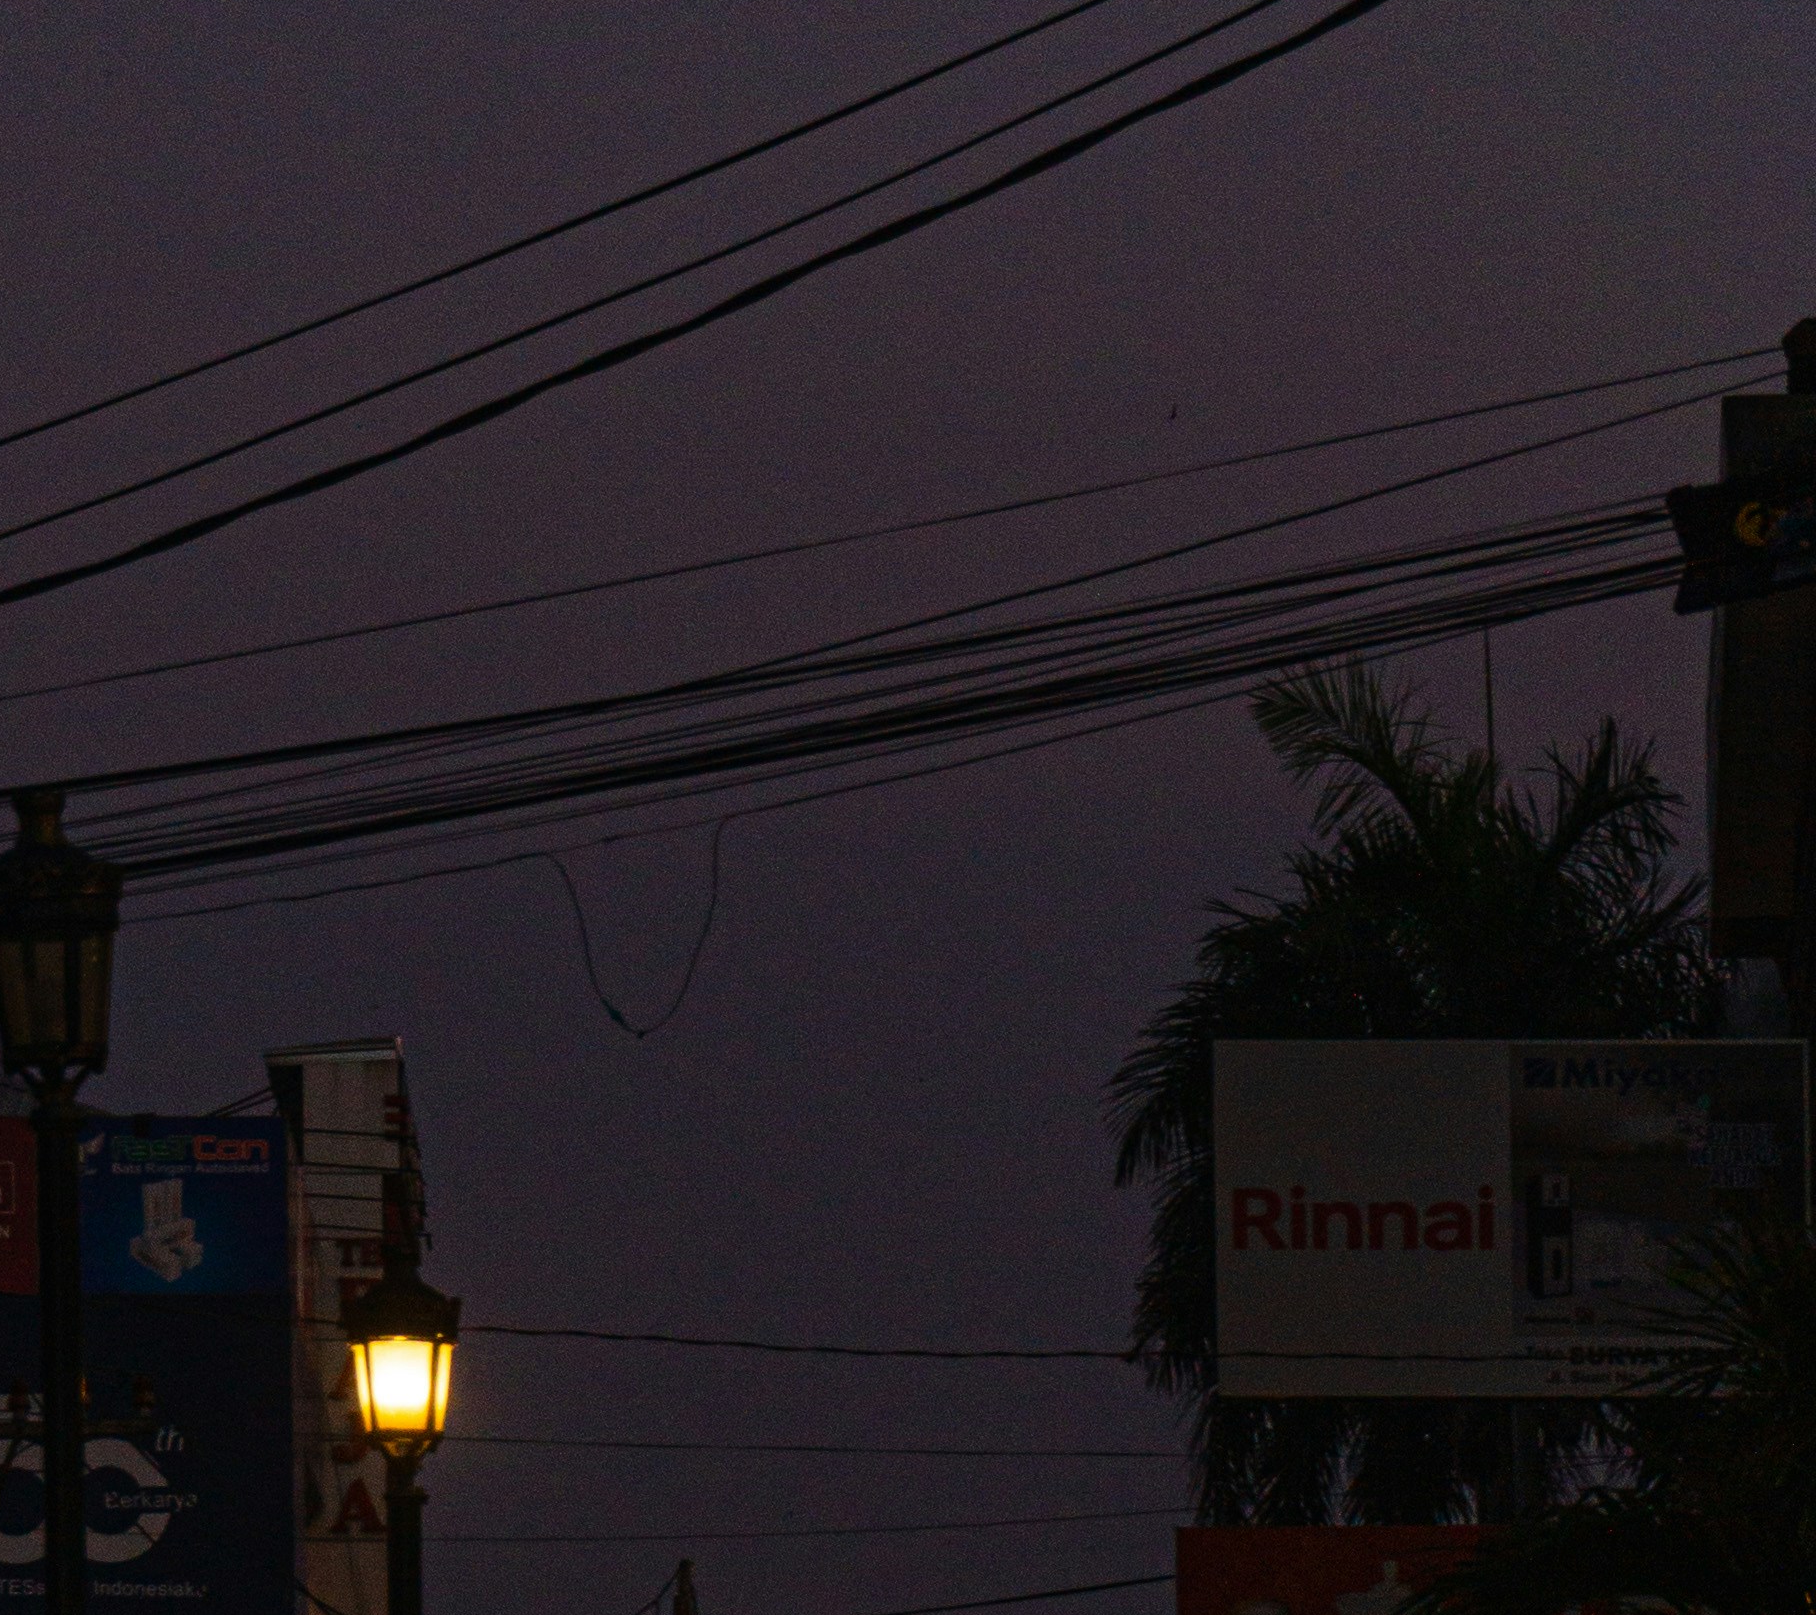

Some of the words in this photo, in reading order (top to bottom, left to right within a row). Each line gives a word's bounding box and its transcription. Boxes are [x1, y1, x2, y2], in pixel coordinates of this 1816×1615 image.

[145, 1163, 192, 1175] Ringan
[1231, 1185, 1495, 1251] Rinnai
[154, 1424, 185, 1453] th
